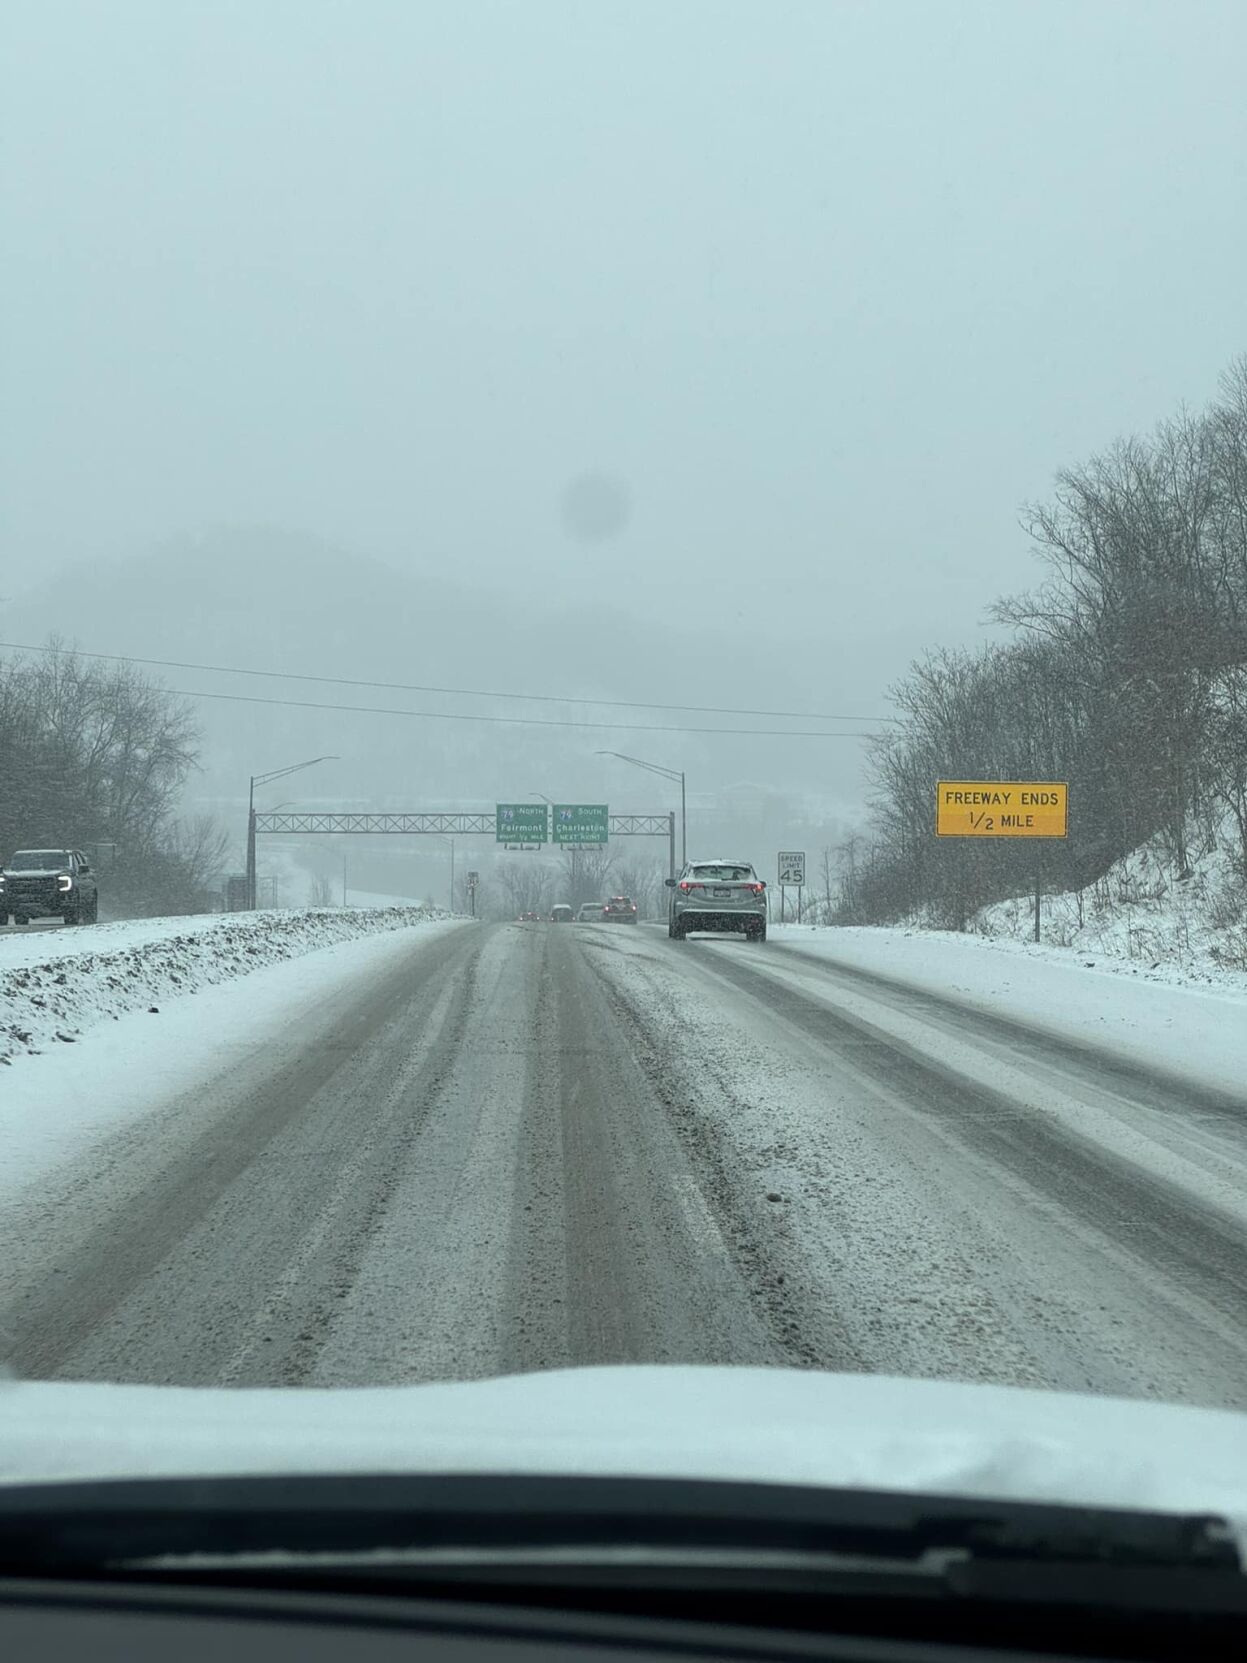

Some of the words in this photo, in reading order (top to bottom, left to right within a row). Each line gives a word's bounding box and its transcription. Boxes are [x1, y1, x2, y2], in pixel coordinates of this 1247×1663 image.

[945, 791, 1012, 805] FREEWAY
[1021, 792, 1059, 806] ENDS
[578, 807, 602, 816] SOUTH
[970, 811, 994, 831] 1/2
[1000, 814, 1034, 828] MILE
[501, 823, 543, 832] Fairmont
[556, 823, 606, 833] Charleston
[780, 869, 803, 883] 45
